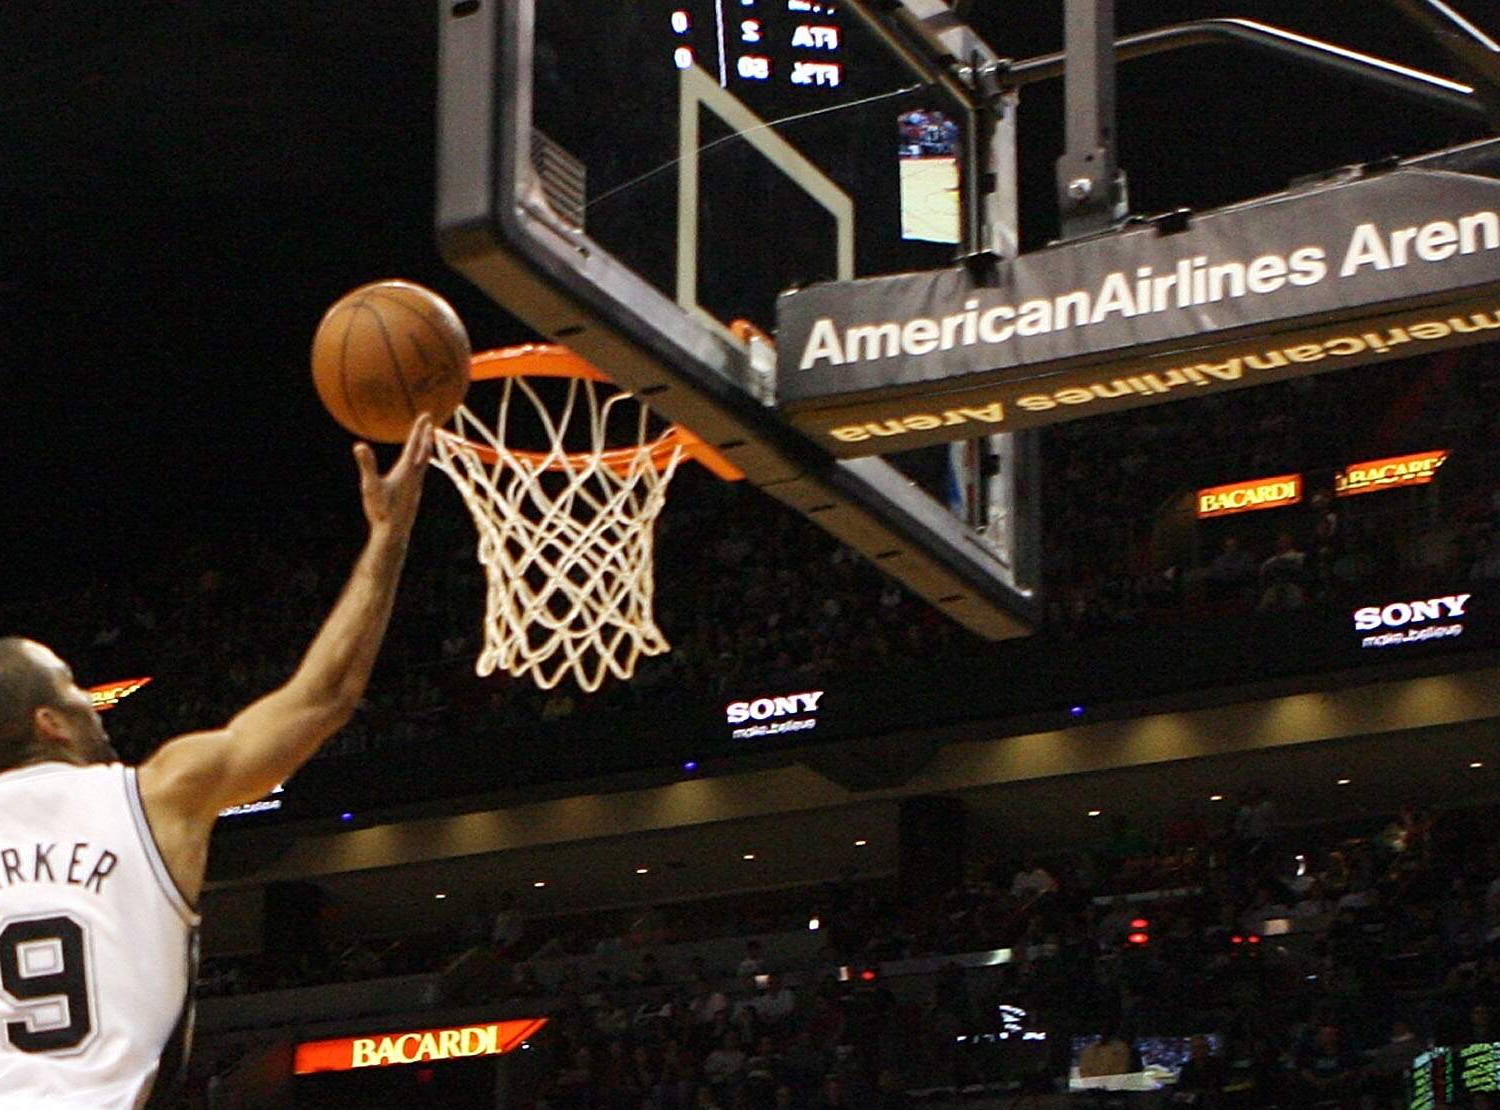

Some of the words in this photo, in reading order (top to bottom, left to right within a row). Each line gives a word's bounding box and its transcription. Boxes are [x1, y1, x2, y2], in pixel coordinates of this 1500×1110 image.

[799, 244, 1328, 371] AmericanAirlines
[1341, 208, 1500, 276] Aren
[829, 401, 1005, 443] Arena
[1200, 481, 1298, 512] BACARDI
[1353, 593, 1472, 631] SONY
[726, 690, 825, 724] SONY
[351, 1025, 503, 1069] BACARDI
